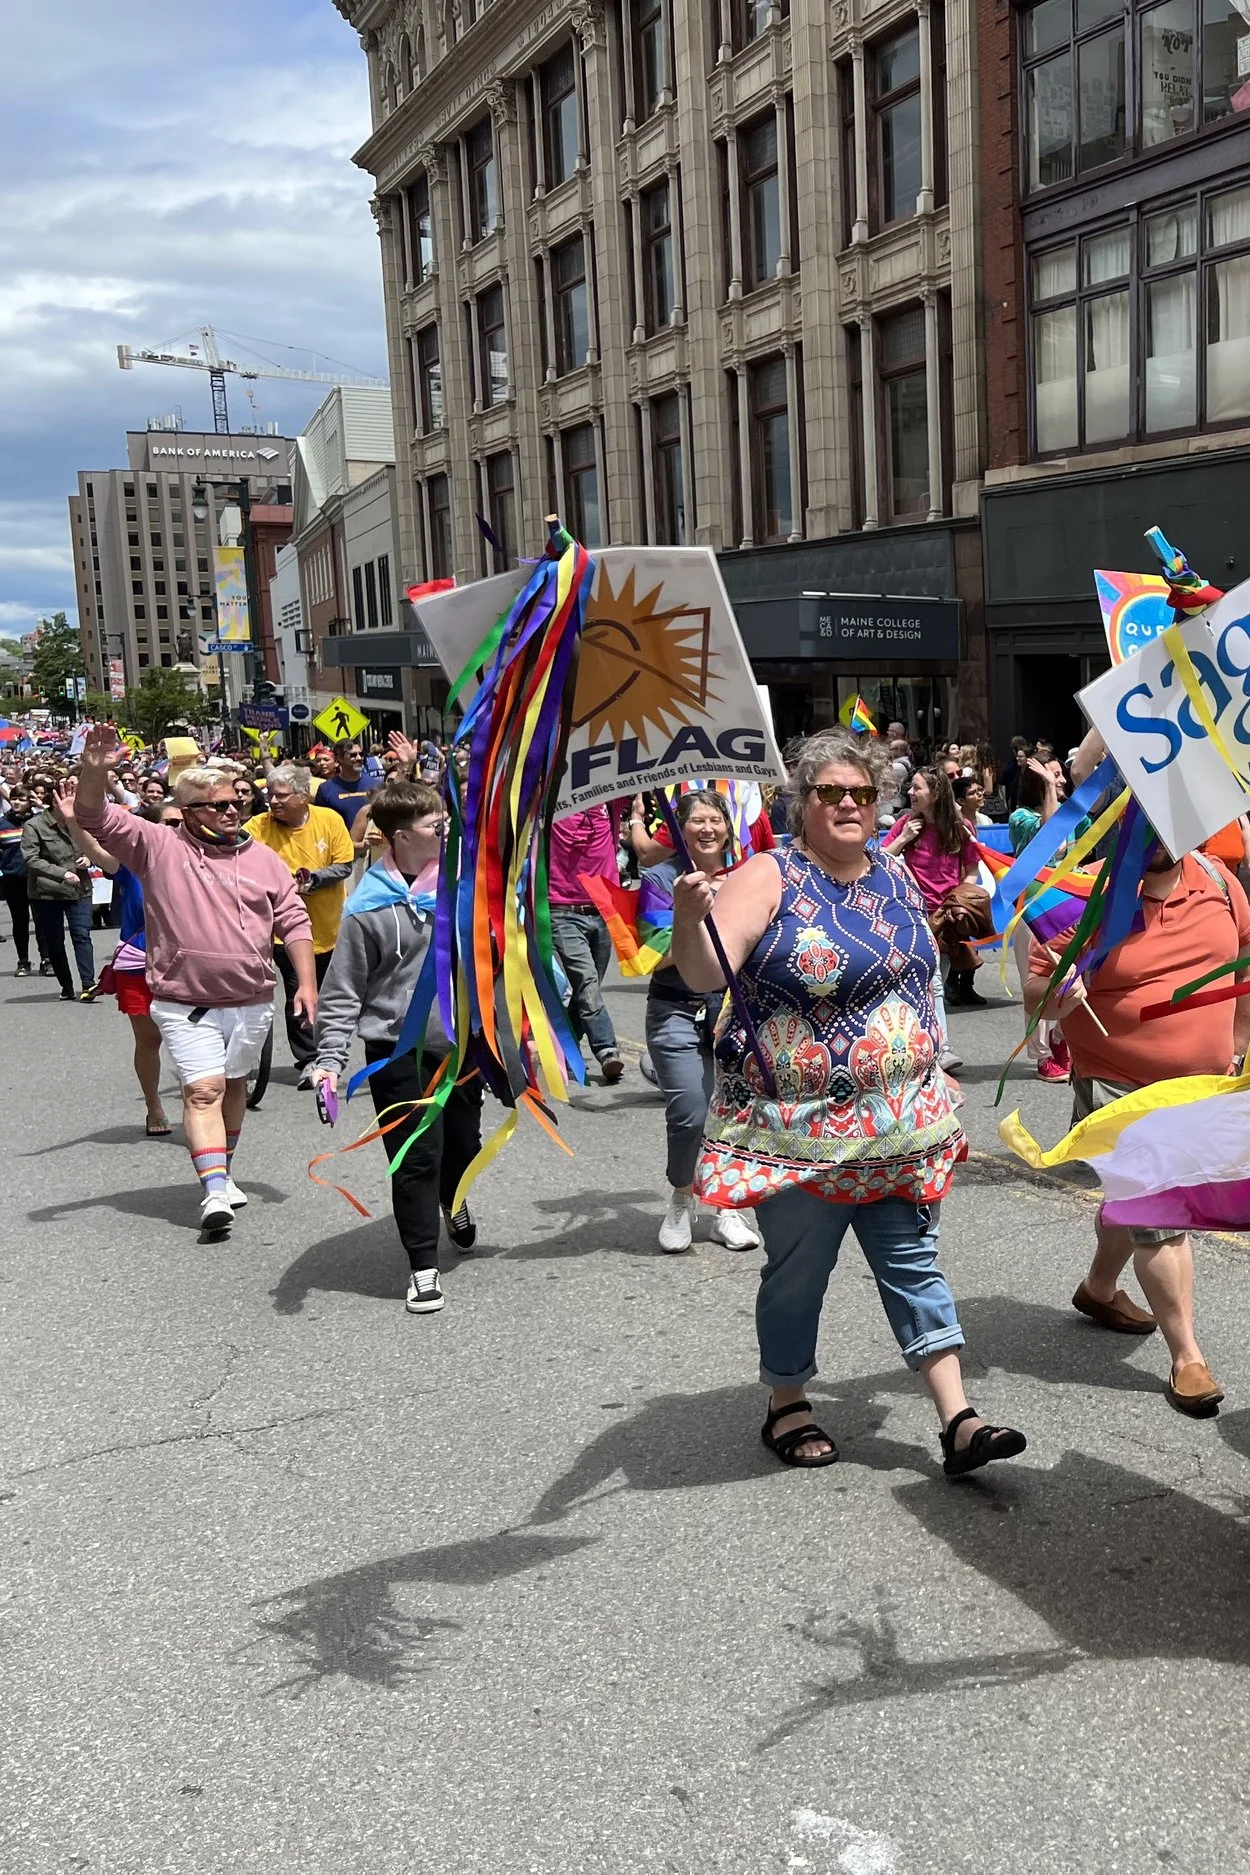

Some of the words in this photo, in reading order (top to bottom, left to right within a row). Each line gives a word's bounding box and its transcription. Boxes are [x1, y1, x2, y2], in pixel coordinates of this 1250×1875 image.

[1153, 71, 1170, 81] YOU
[152, 446, 184, 456] BANK
[204, 449, 255, 459] AMERICA
[841, 617, 874, 627] MAINE
[877, 618, 921, 628] COLLEGE
[841, 628, 855, 638] OF
[857, 629, 876, 638] ART
[877, 629, 884, 639] &
[886, 630, 921, 640] DESIGN
[210, 644, 233, 652] CASCO
[565, 726, 766, 790] FLAG
[571, 783, 615, 804] Families
[616, 775, 636, 789] and
[636, 767, 677, 784] Friends
[678, 763, 689, 774] of
[690, 762, 733, 773] Lesbians
[734, 764, 753, 774] and
[754, 765, 778, 777] Gays
